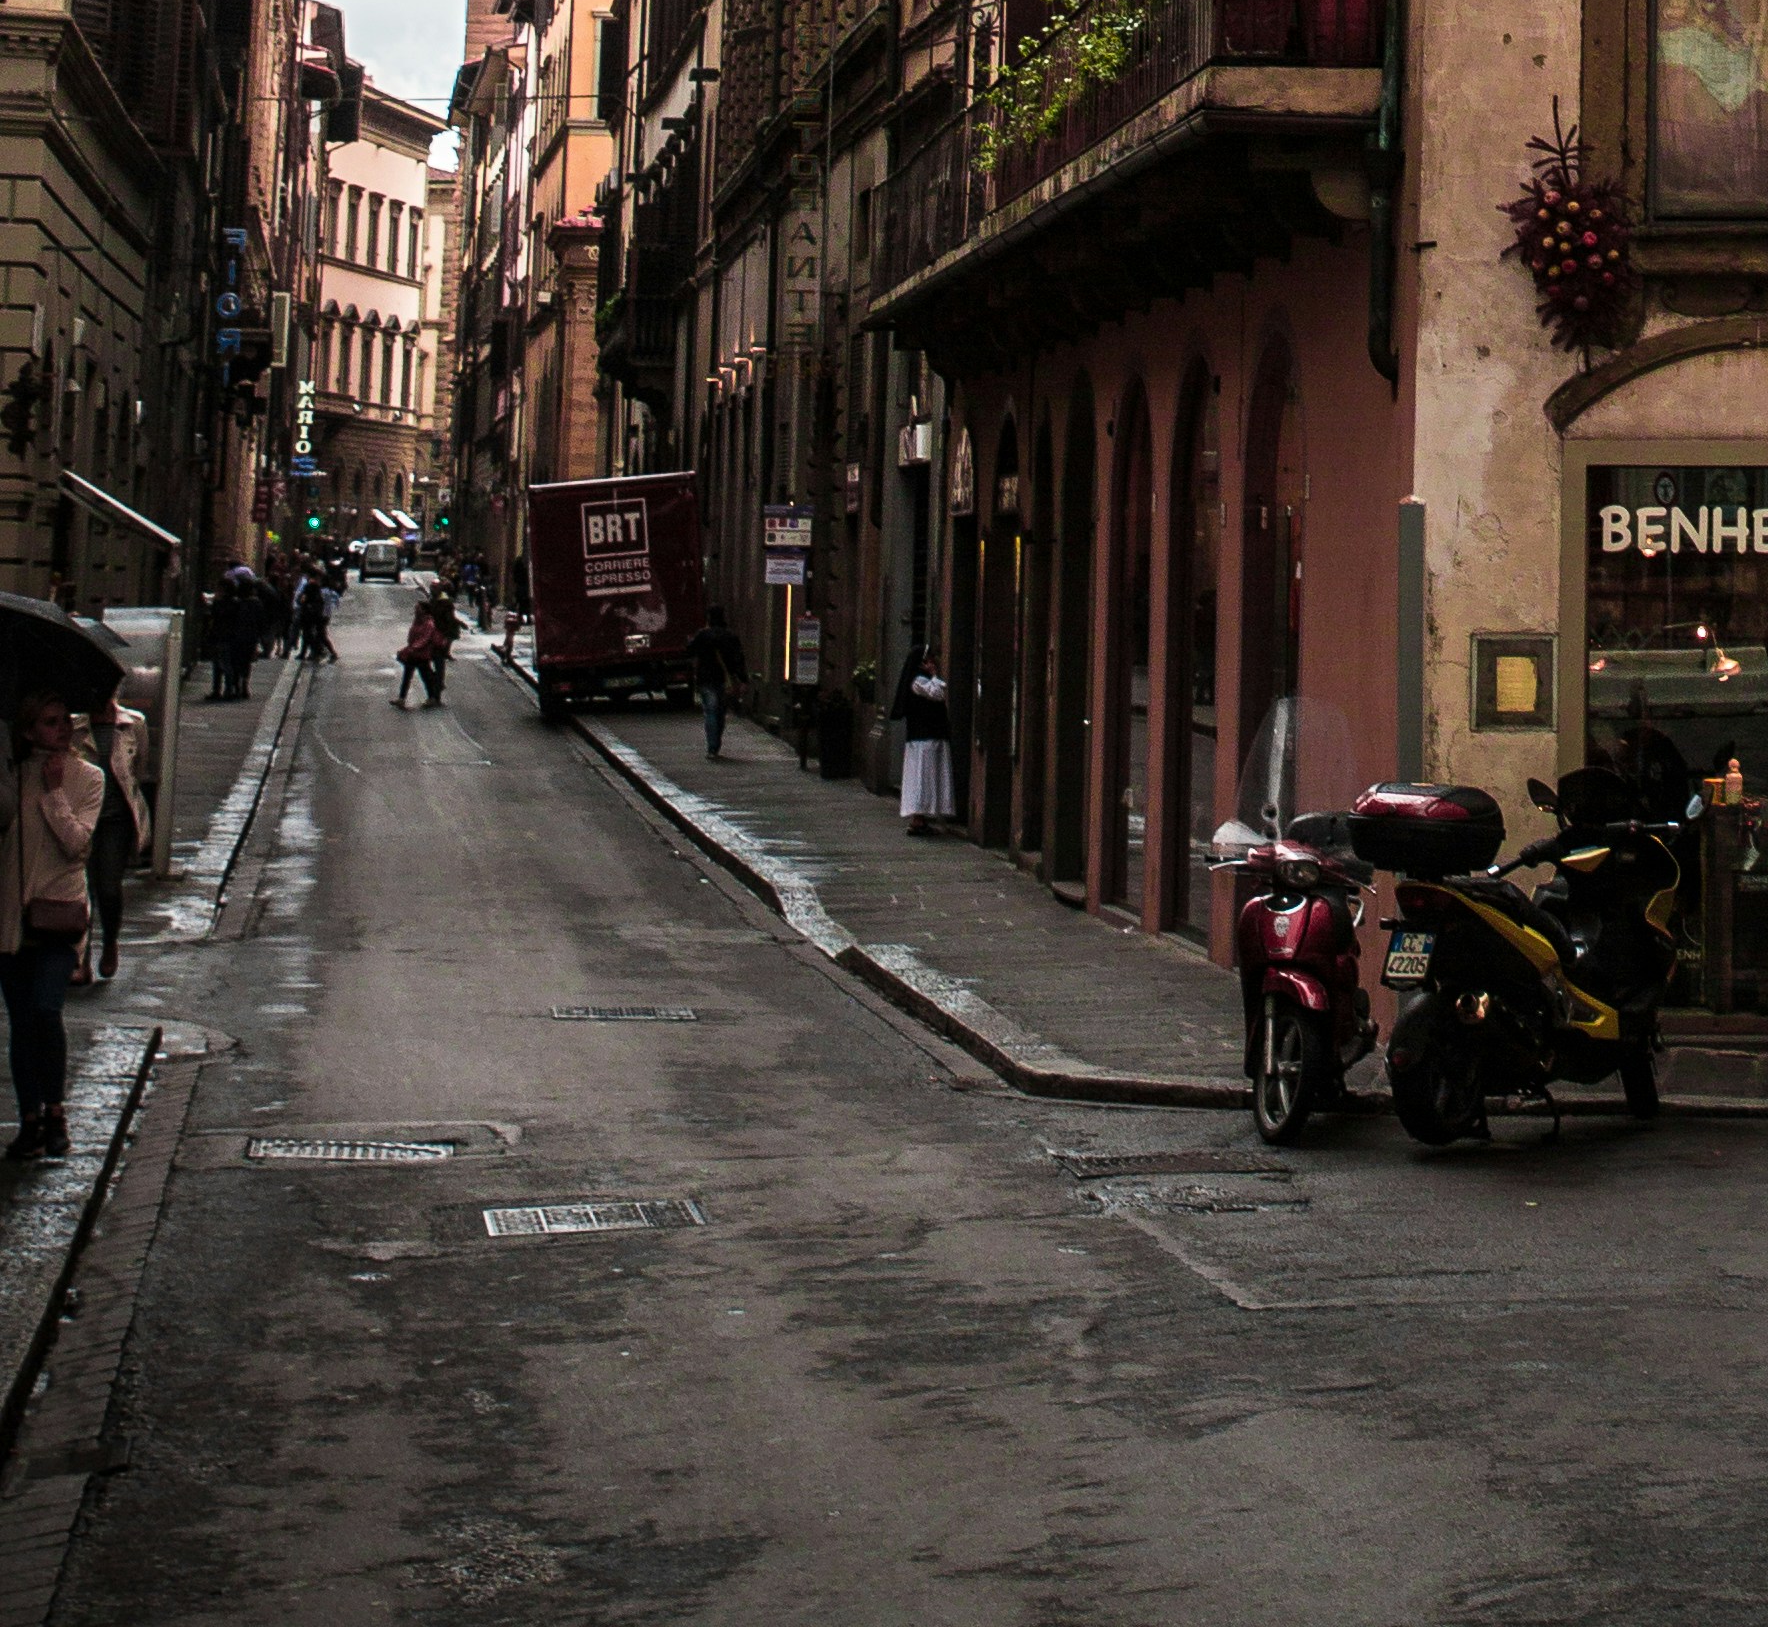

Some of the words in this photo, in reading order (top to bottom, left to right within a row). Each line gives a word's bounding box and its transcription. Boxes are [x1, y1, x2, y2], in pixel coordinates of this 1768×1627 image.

[588, 511, 641, 545] BRT
[584, 557, 651, 574] CORRIERE
[584, 569, 652, 586] ESPRESSO
